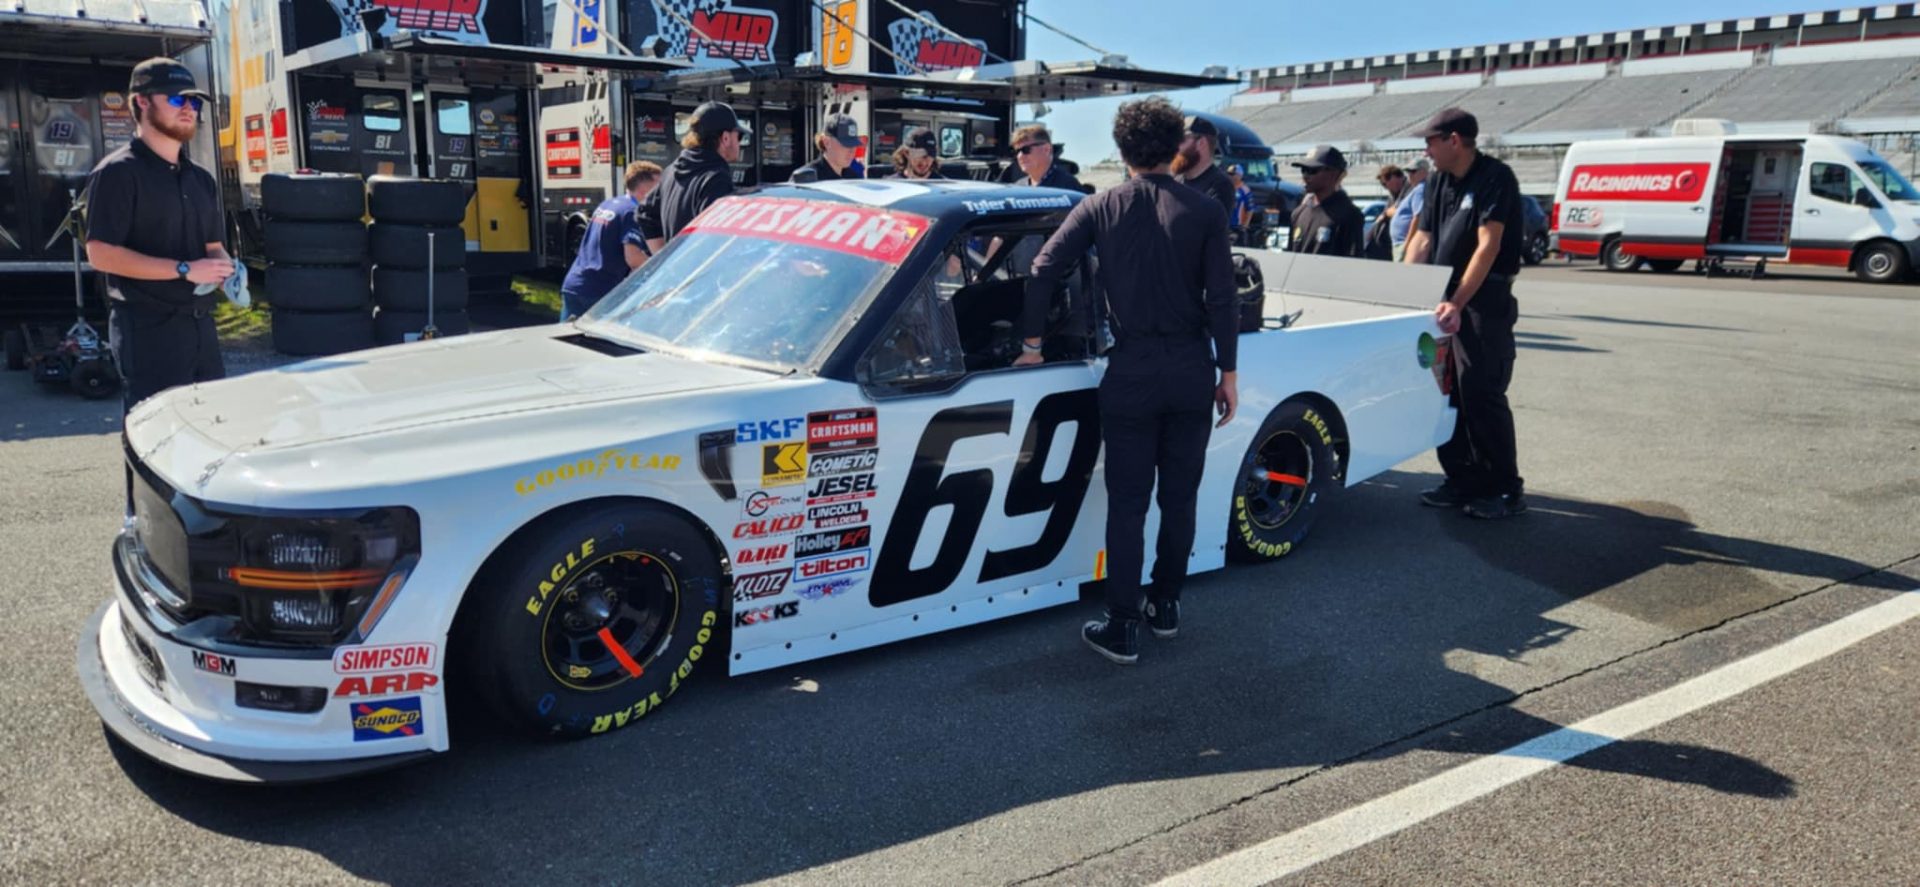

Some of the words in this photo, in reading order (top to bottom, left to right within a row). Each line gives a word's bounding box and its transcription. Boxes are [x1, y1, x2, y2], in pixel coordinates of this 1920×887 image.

[686, 9, 774, 61] MHR
[374, 134, 392, 149] 81
[450, 163, 468, 177] 91
[961, 200, 1006, 215] Tyler
[736, 417, 805, 443] SKF
[811, 421, 875, 439] CRAFTSMAN
[1302, 409, 1332, 446] EAGLE
[514, 448, 683, 497] GOODYEAR
[810, 449, 877, 474] COMETIC
[807, 472, 878, 499] JESEL
[868, 387, 1105, 609] 69
[810, 502, 860, 519] LINCOLN
[820, 513, 863, 527] WELDERS
[732, 514, 806, 539] CALICO
[797, 533, 841, 552] Holley
[526, 537, 595, 617] EAGLE
[800, 556, 865, 577] tilton
[733, 574, 785, 598] KLOTZ
[341, 645, 429, 671] SIMPSON
[333, 672, 439, 697] ARP
[357, 710, 419, 729] SUNOCO
